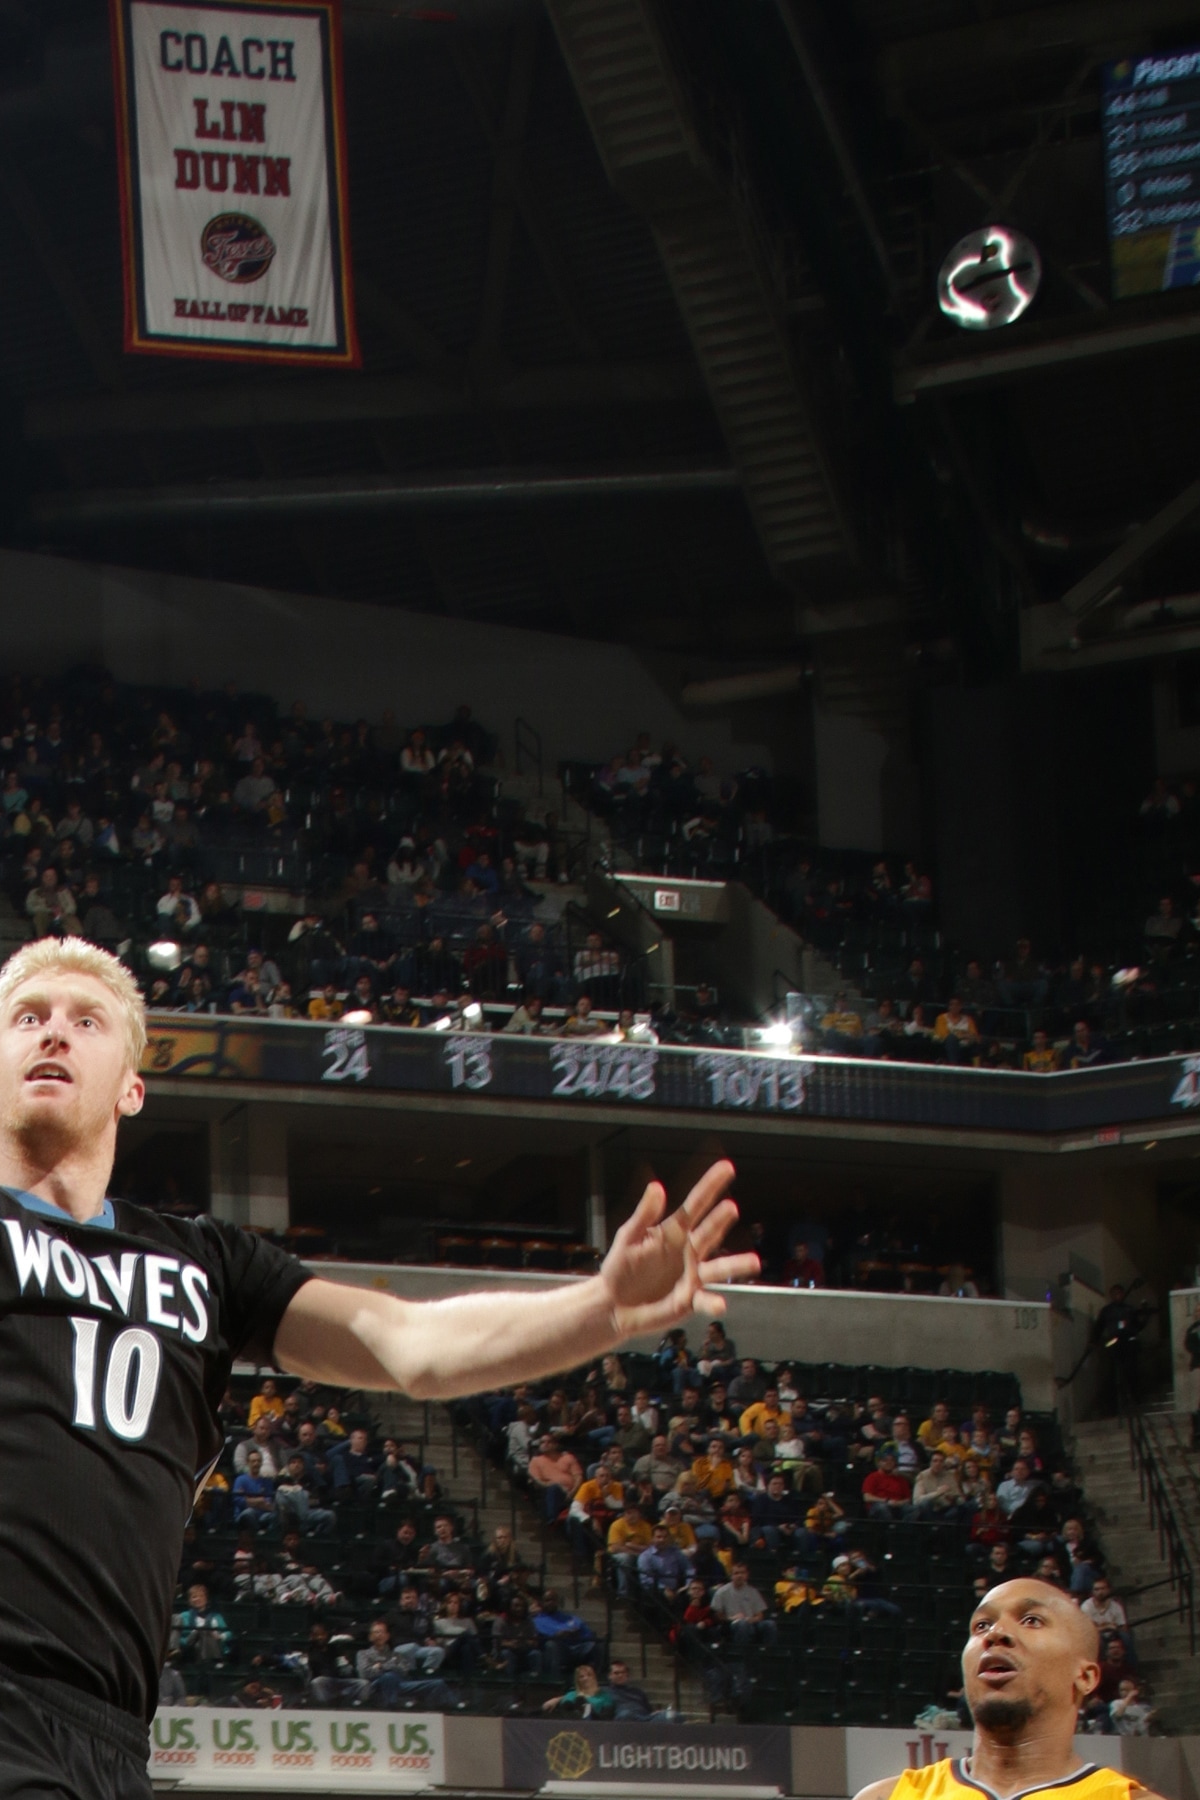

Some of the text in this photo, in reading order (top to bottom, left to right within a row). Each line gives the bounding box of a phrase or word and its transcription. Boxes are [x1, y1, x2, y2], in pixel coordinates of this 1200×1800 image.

[159, 30, 296, 81] COACH
[193, 98, 266, 143] LIN
[174, 149, 291, 196] DUNN
[174, 298, 227, 321] HALL
[252, 305, 308, 327] FAME
[320, 1042, 372, 1082] 24
[445, 1049, 493, 1090] 13
[706, 1069, 806, 1110] 10/13
[0, 1219, 210, 1342] WOLVES
[69, 1316, 162, 1441] 10
[154, 1751, 196, 1765] FOODS
[213, 1752, 255, 1765] FOODS
[272, 1753, 314, 1767] FOODS
[331, 1755, 373, 1768] FOODS
[389, 1756, 430, 1769] FOODS
[599, 1743, 747, 1771] LIGHTBOUND
